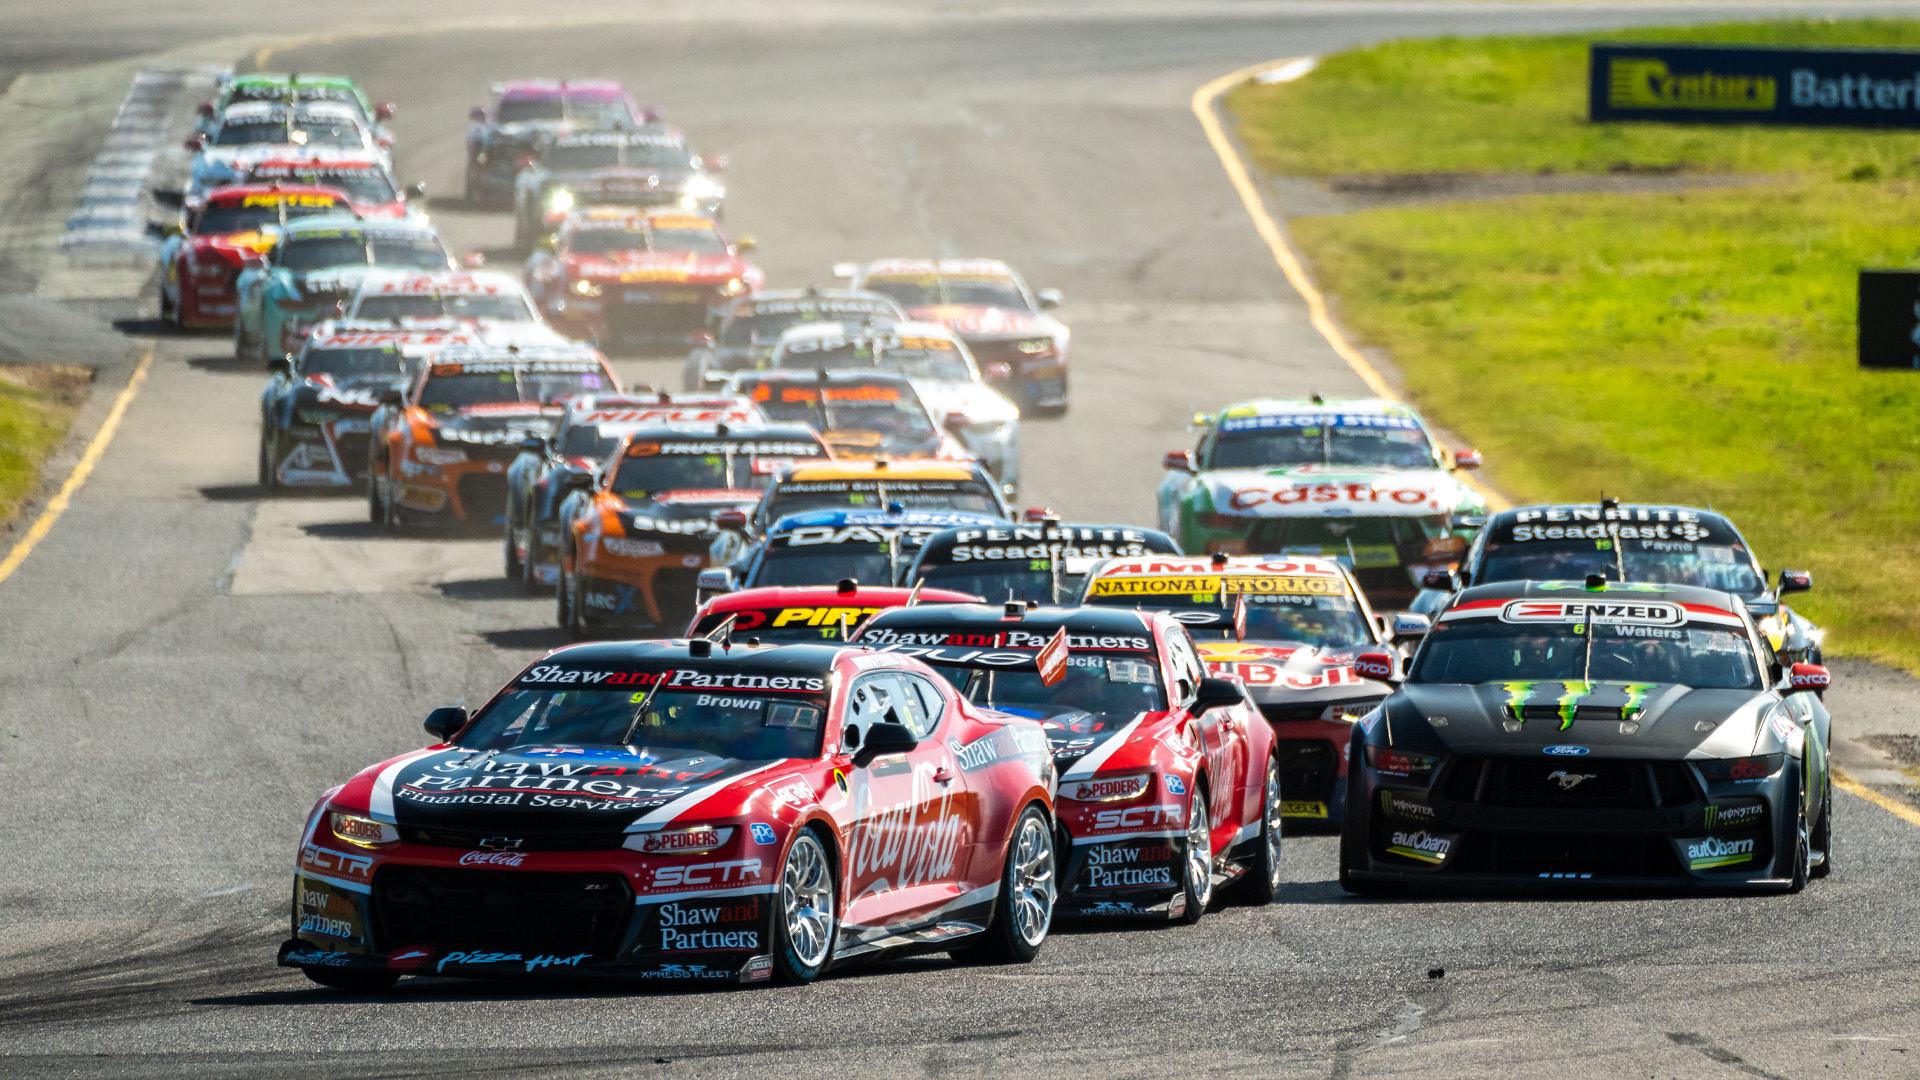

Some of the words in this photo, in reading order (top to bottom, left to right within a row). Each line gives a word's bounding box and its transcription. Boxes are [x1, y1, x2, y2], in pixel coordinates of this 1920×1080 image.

[1512, 522, 1671, 542] Steadfast
[1095, 577, 1214, 596] NATIONAL
[1226, 577, 1343, 594] STORAGE
[772, 607, 886, 628] PIRT
[1565, 603, 1658, 620] ENZED
[1573, 623, 1586, 635] 6
[1614, 624, 1682, 639] Waters
[1066, 655, 1105, 668] ecki
[1355, 660, 1390, 675] RYCO
[1791, 674, 1829, 686] RYCO
[630, 691, 646, 704] 9
[696, 693, 763, 710] Brown
[404, 772, 690, 800] Partners
[1092, 778, 1141, 796] PEDDERS
[394, 786, 519, 808] Financial
[529, 791, 668, 812] Services
[1094, 804, 1182, 829] SCTR
[1718, 804, 1764, 821] MONSTER
[343, 818, 383, 839] PEDDERS
[661, 830, 720, 849] PEDDERS
[303, 842, 373, 877] SCTR
[652, 858, 762, 888] SCTR
[1088, 867, 1170, 888] Partners
[660, 928, 758, 951] Partners
[437, 950, 523, 974] Pizza
[525, 953, 595, 973] Hut
[640, 970, 691, 979] XPRESS
[694, 970, 732, 979] FLEET
